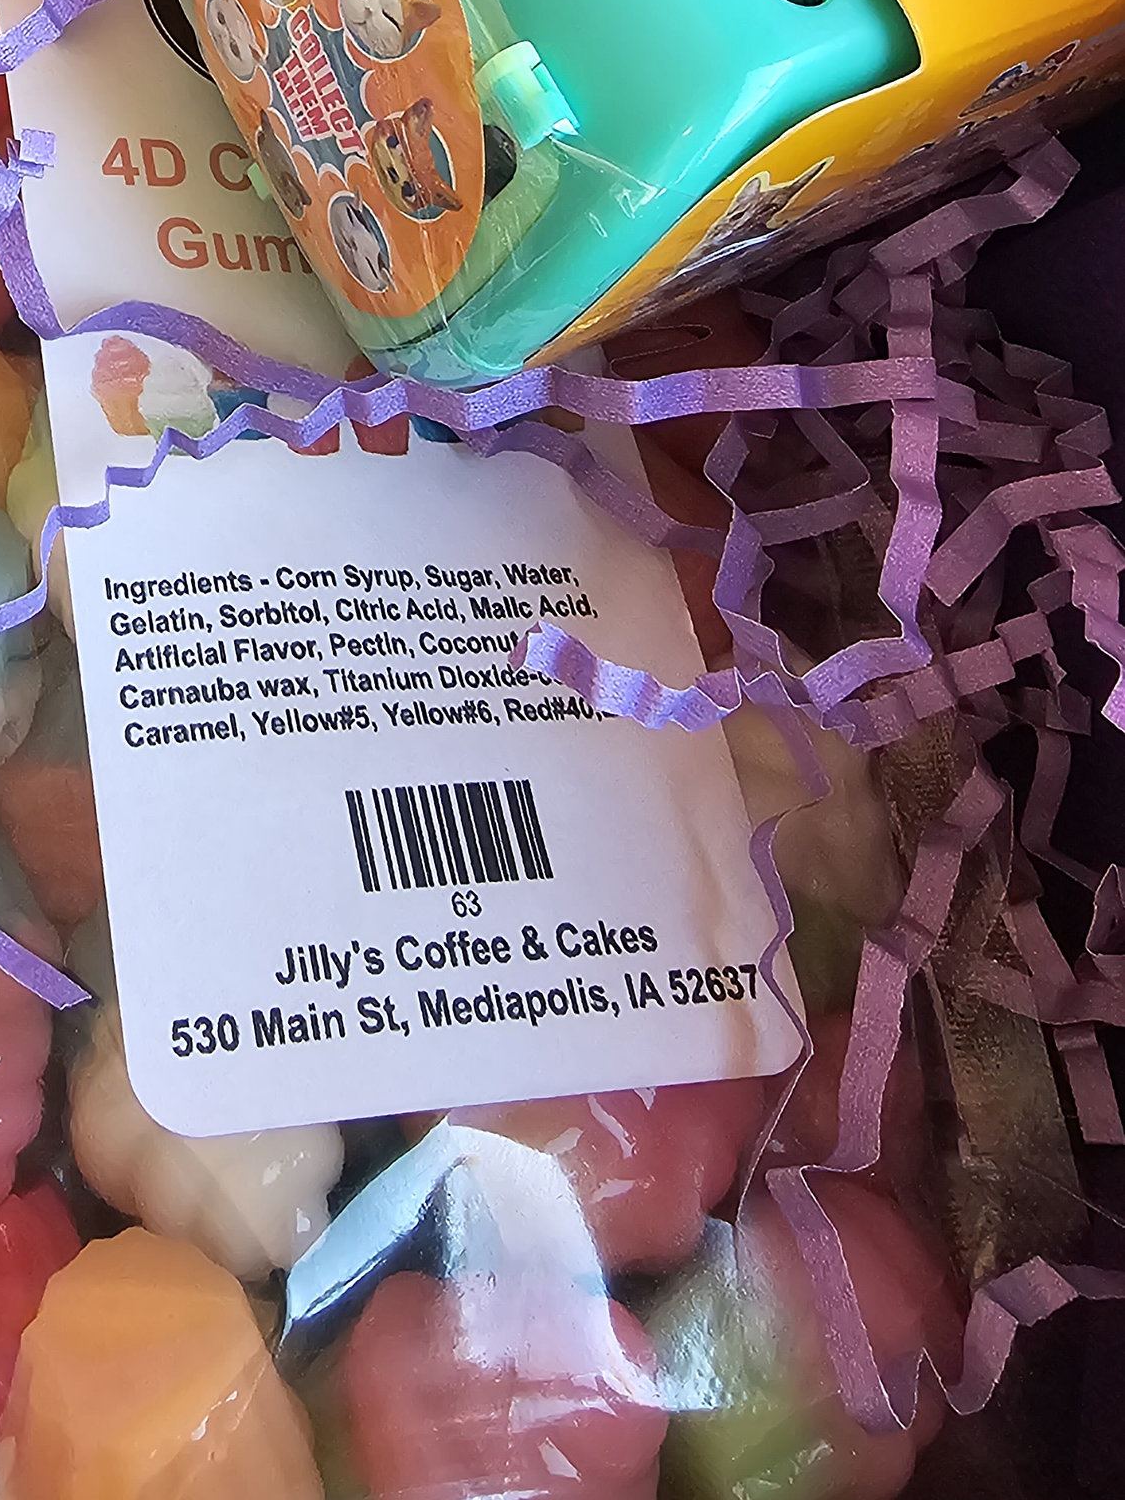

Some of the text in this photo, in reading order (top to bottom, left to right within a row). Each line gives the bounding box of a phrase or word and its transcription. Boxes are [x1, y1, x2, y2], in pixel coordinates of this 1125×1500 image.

[285, 49, 331, 136] THEM
[289, 8, 367, 152] COLLECT
[102, 137, 186, 187] 4D
[104, 571, 254, 604] Ingredients
[275, 566, 337, 590] Corn
[343, 564, 421, 592] Syrup,
[424, 564, 502, 593] Sugar,
[502, 563, 580, 588] Water,
[110, 593, 598, 636] Gelatin, Sorbitol, Citric Acid, Malic Acid,
[115, 640, 227, 672] Artificial
[233, 637, 323, 662] Flavor,
[329, 632, 415, 659] Pectin,
[119, 676, 251, 709] Carnauba
[257, 676, 319, 698] wax,
[323, 667, 433, 694] Titanium
[124, 696, 602, 748] Caramel, Yellow#5, Yellow#6, Red#40,
[450, 890, 482, 918] 63
[275, 920, 658, 989] Jilly's Coffee & Cakes
[172, 963, 758, 1057] 530 Main St, Mediapolis, IA 52637
